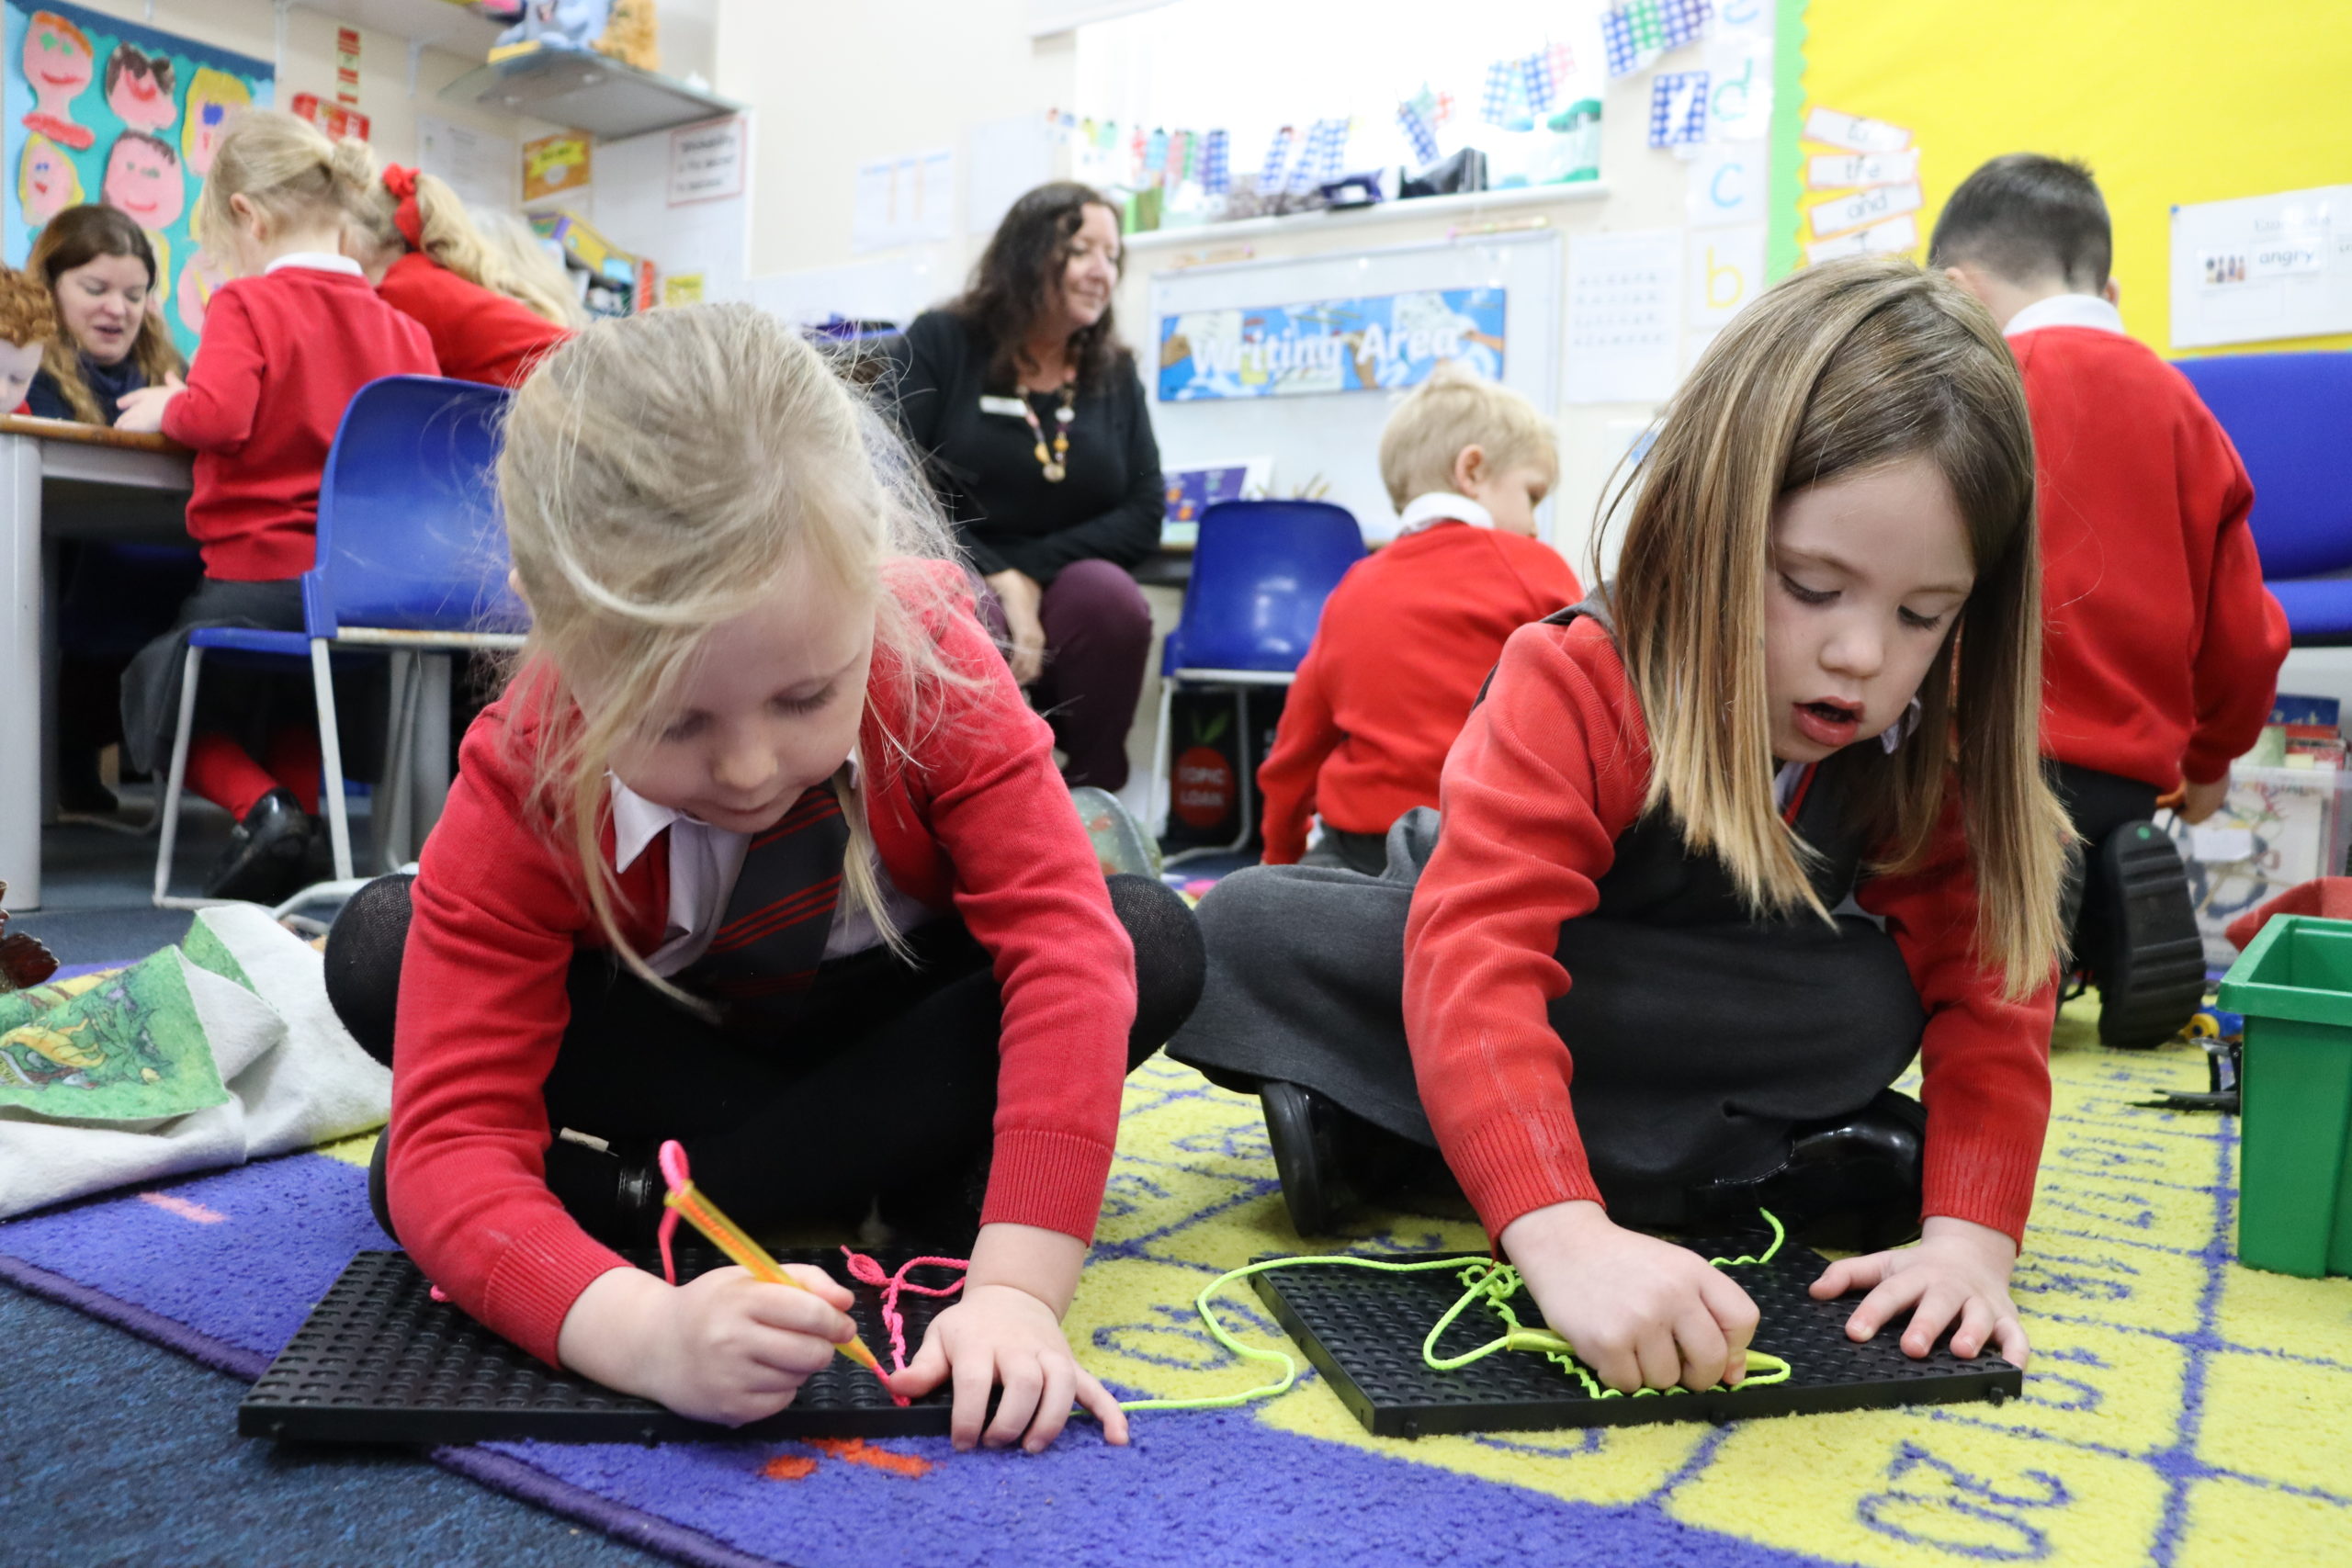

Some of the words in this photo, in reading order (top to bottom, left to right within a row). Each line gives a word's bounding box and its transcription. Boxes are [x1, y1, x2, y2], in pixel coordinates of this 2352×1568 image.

[1711, 57, 1754, 122] d
[1710, 163, 1745, 209] c
[1847, 187, 1888, 220] and
[1705, 244, 1745, 310] b
[2259, 250, 2313, 266] angry
[1192, 323, 1344, 378] Writing
[1355, 321, 1461, 365] Area
[1857, 1438, 2074, 1562] 20
